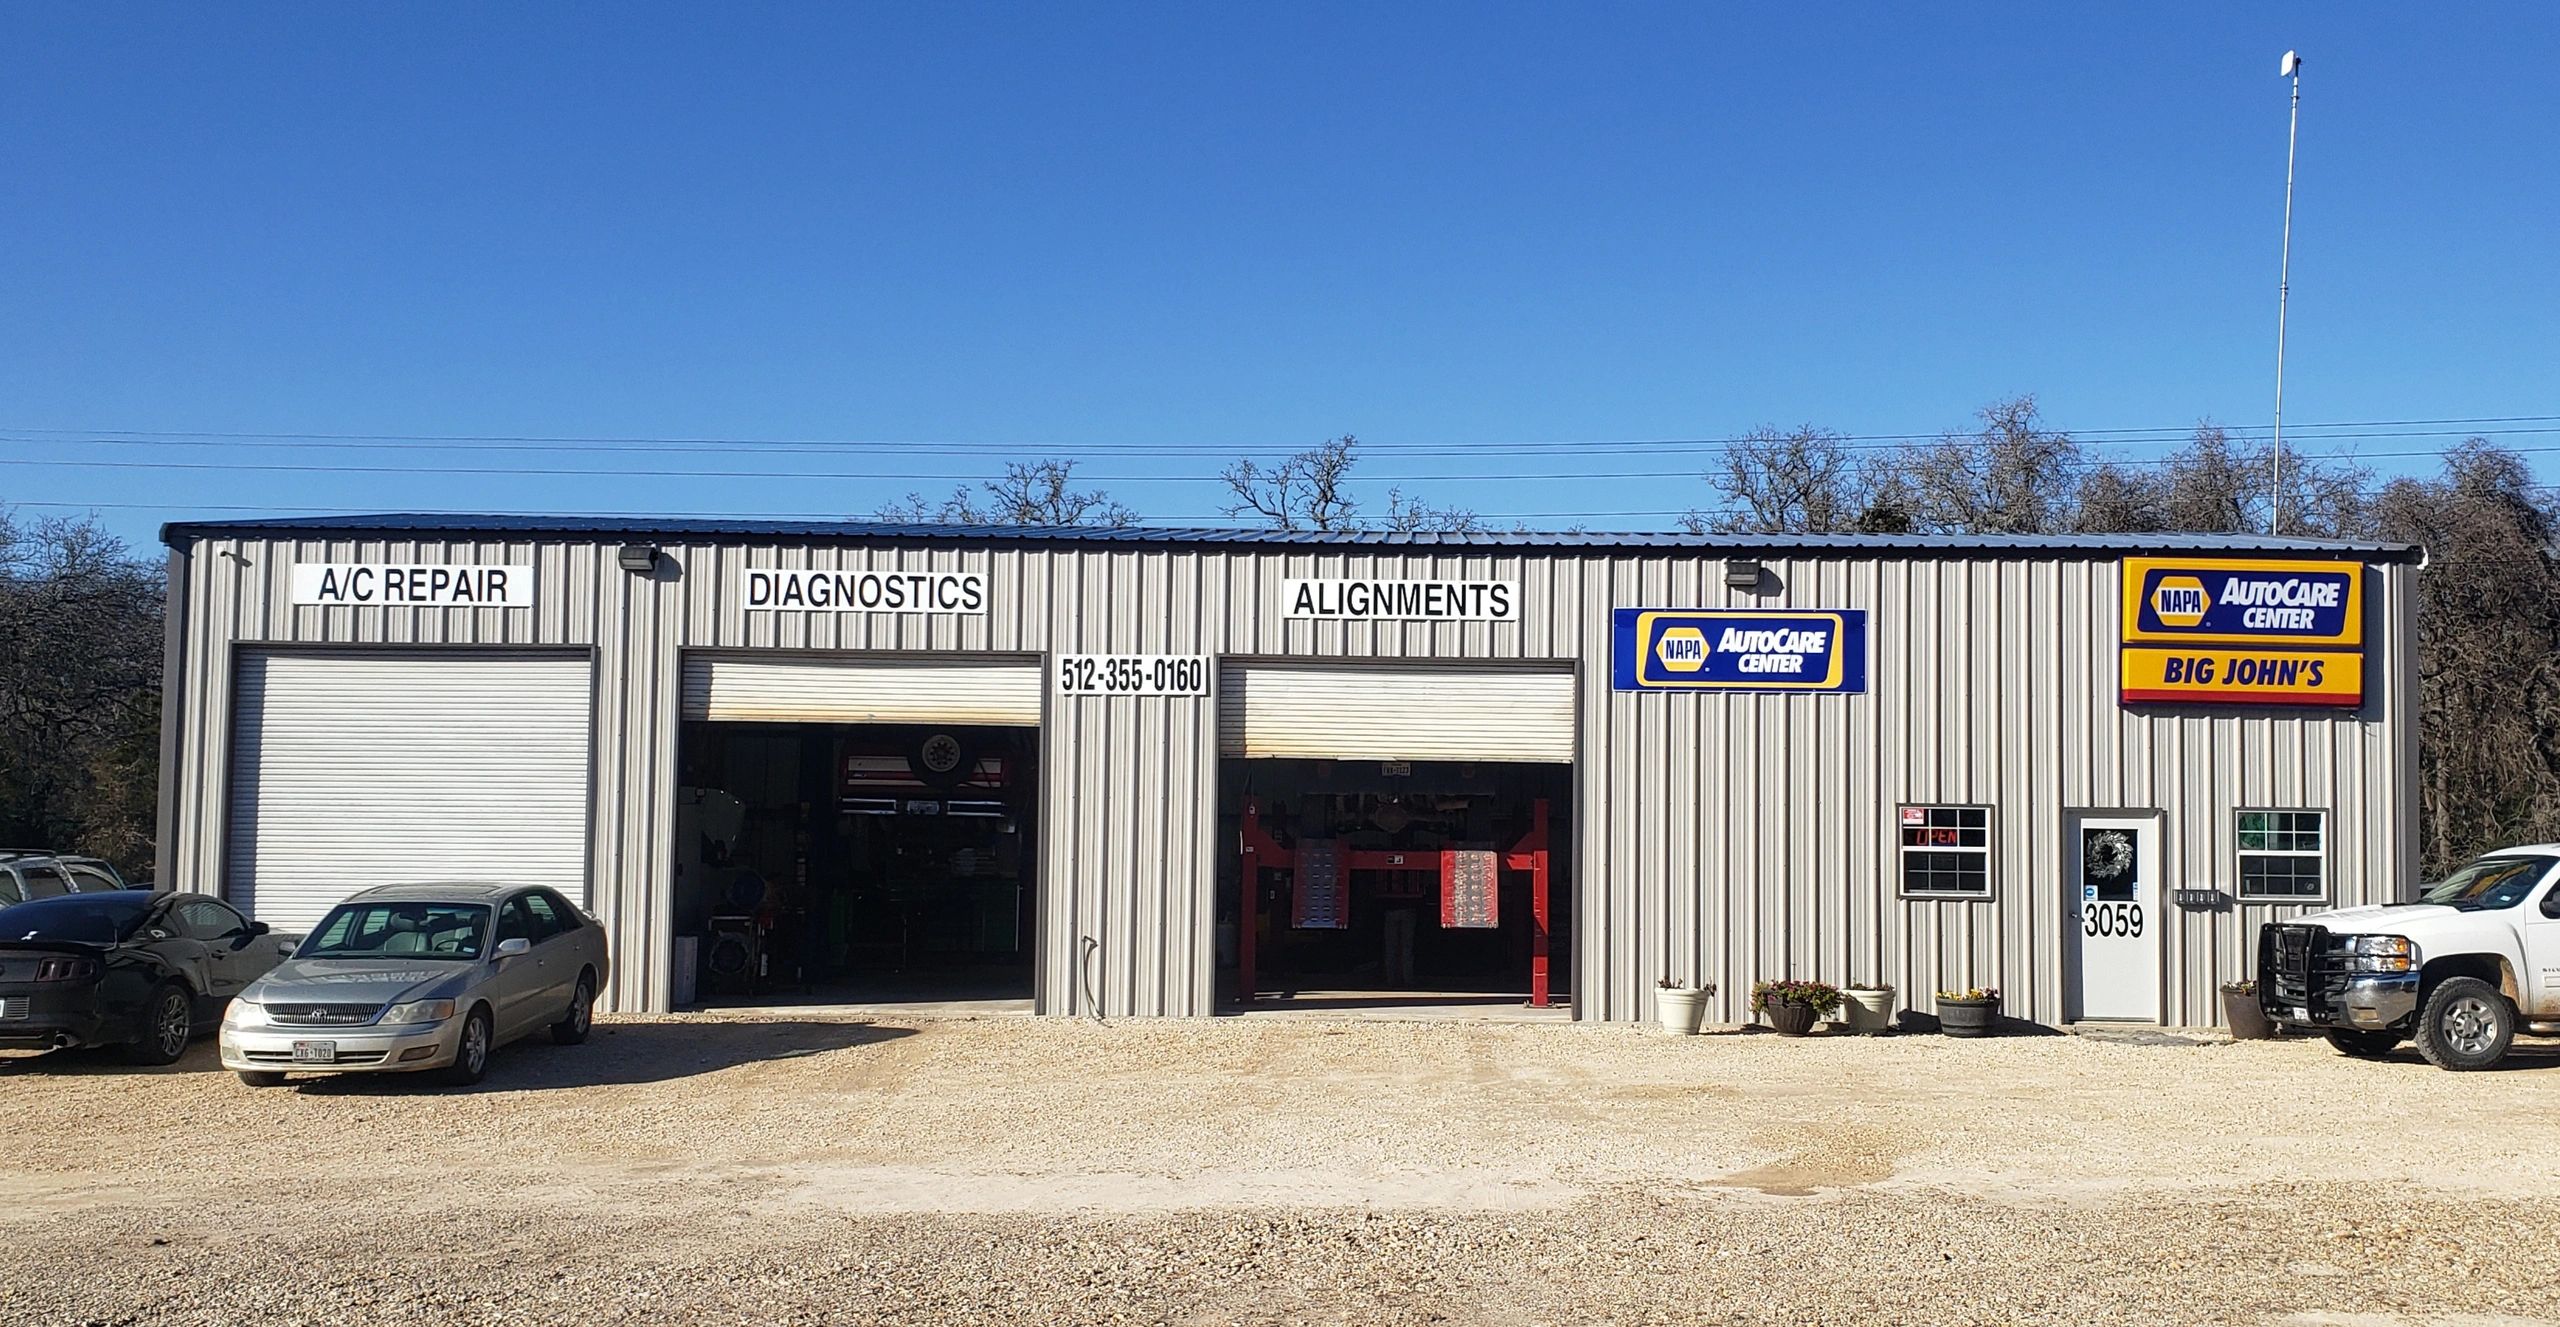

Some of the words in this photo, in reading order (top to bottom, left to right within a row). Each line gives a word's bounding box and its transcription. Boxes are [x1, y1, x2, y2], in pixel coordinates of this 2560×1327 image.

[318, 567, 374, 601] A/C
[384, 568, 508, 602] REPAIR
[749, 572, 983, 610] DIAGNOSTICS
[1293, 582, 1510, 617] ALIGNMENTS
[2160, 589, 2202, 614] NAPA
[2242, 607, 2316, 630] CENTER
[1664, 639, 1702, 660] NAPA
[1738, 654, 1804, 673] CENTER
[1062, 657, 1201, 692] 512-355-0160
[2163, 657, 2216, 684] BIG
[2221, 658, 2325, 687] JOHN'S
[1916, 828, 1957, 846] OPEN
[2084, 903, 2144, 938] 3059
